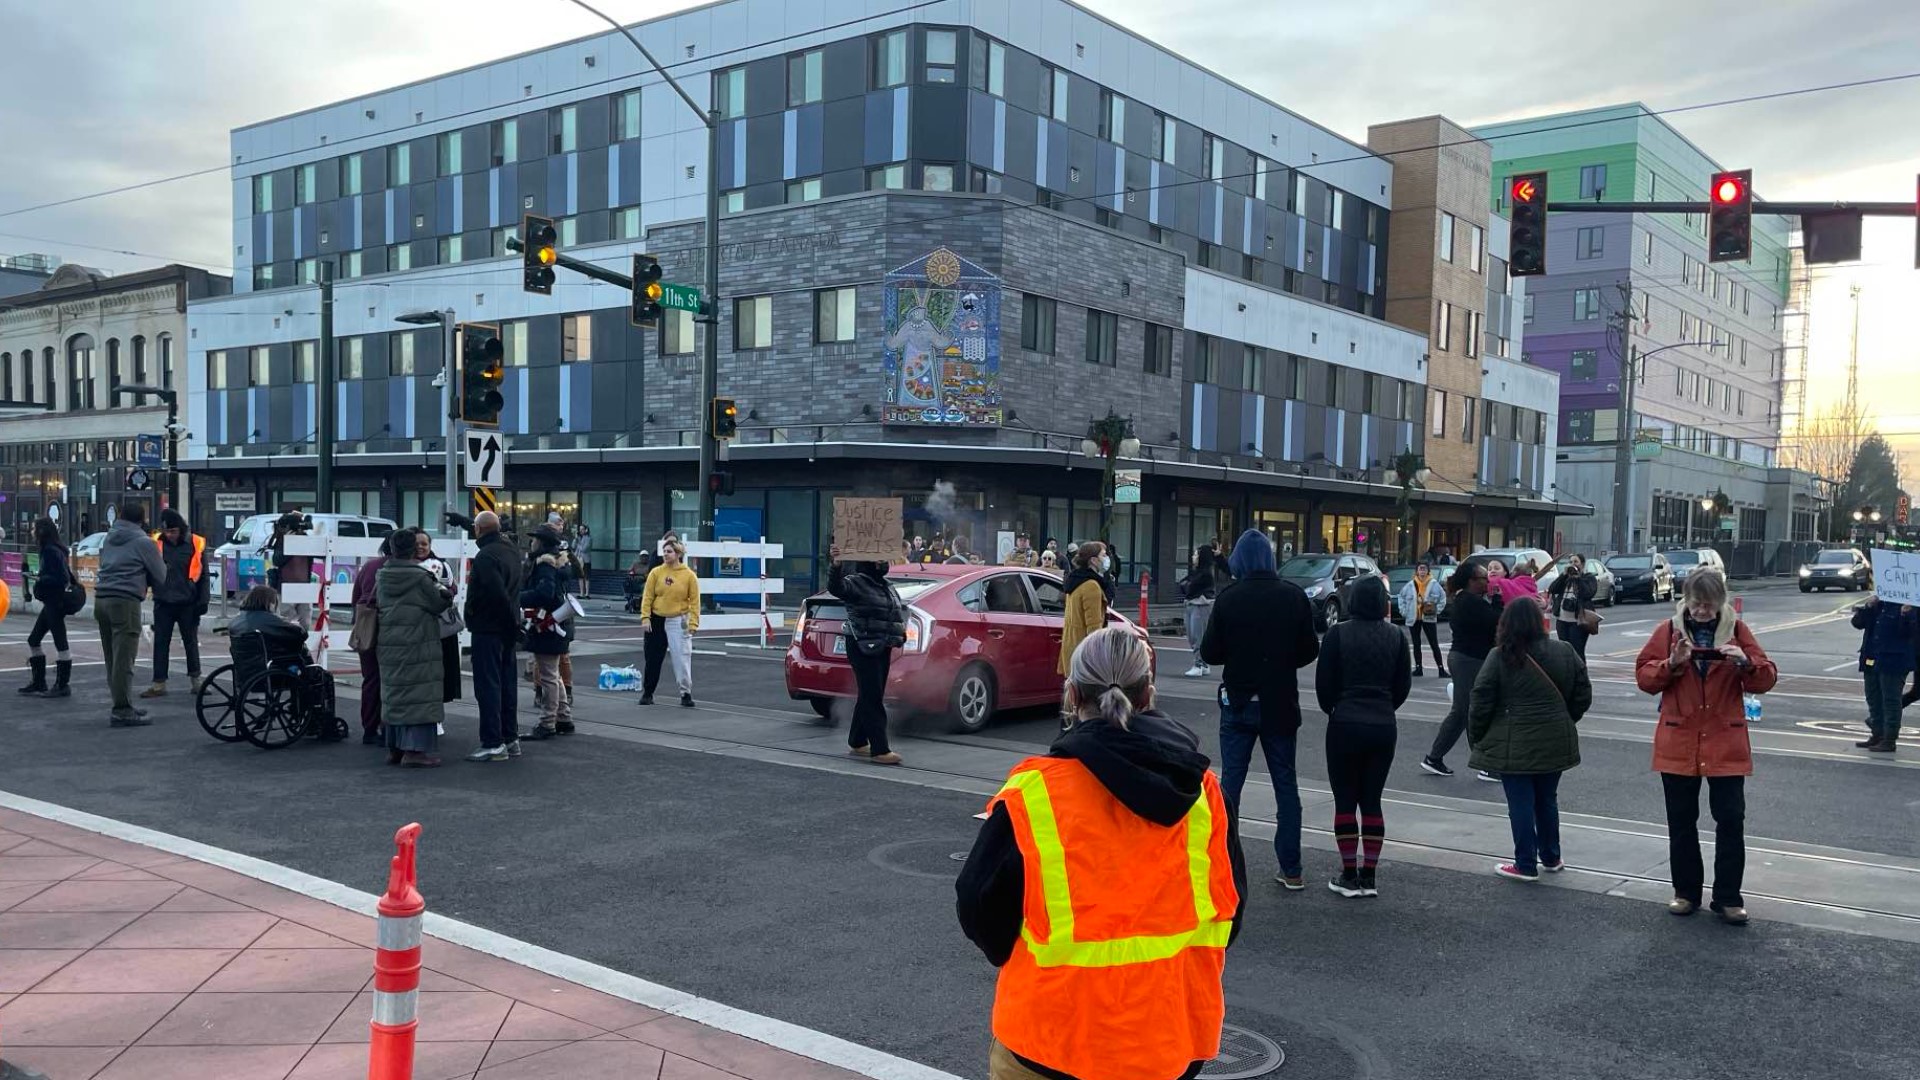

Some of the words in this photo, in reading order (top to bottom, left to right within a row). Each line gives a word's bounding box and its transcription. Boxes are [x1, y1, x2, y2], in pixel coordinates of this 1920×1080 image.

[665, 287, 684, 307] 11th
[688, 293, 698, 308] St
[843, 538, 894, 555] ELLIS
[1890, 552, 1906, 569] I
